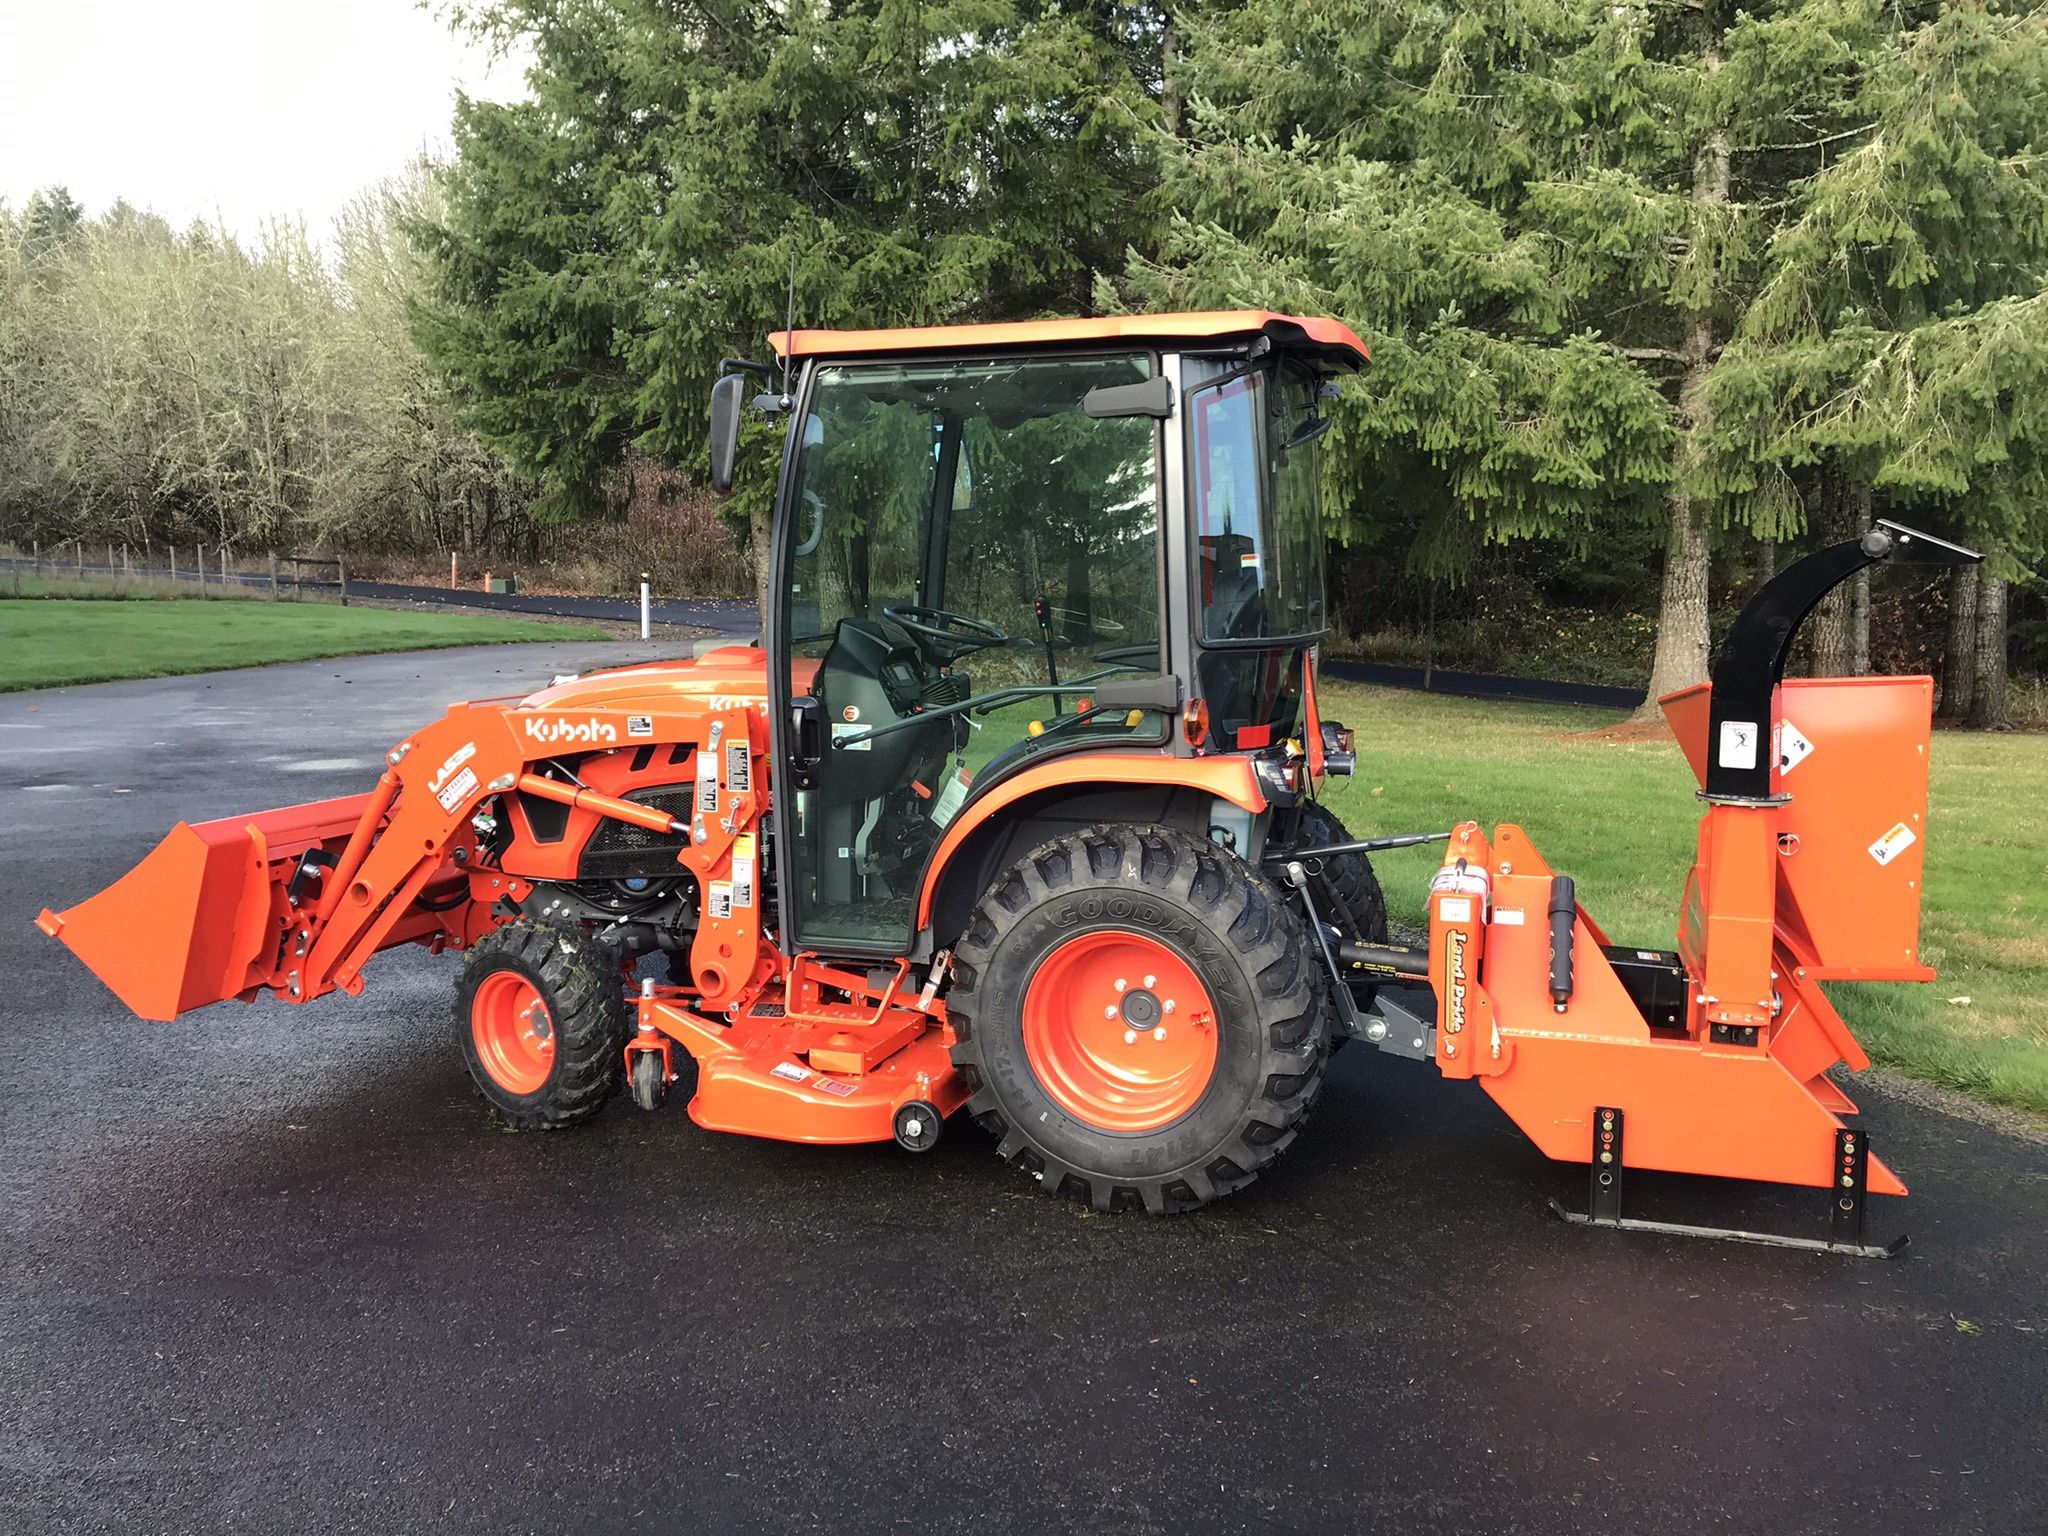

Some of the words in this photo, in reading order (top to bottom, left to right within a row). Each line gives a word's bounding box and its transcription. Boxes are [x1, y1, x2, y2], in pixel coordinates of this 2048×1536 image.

[525, 717, 616, 742] Kubota
[1051, 898, 1254, 1058] GOODYEAR
[1453, 932, 1468, 979] Land
[1453, 984, 1467, 1032] Pride
